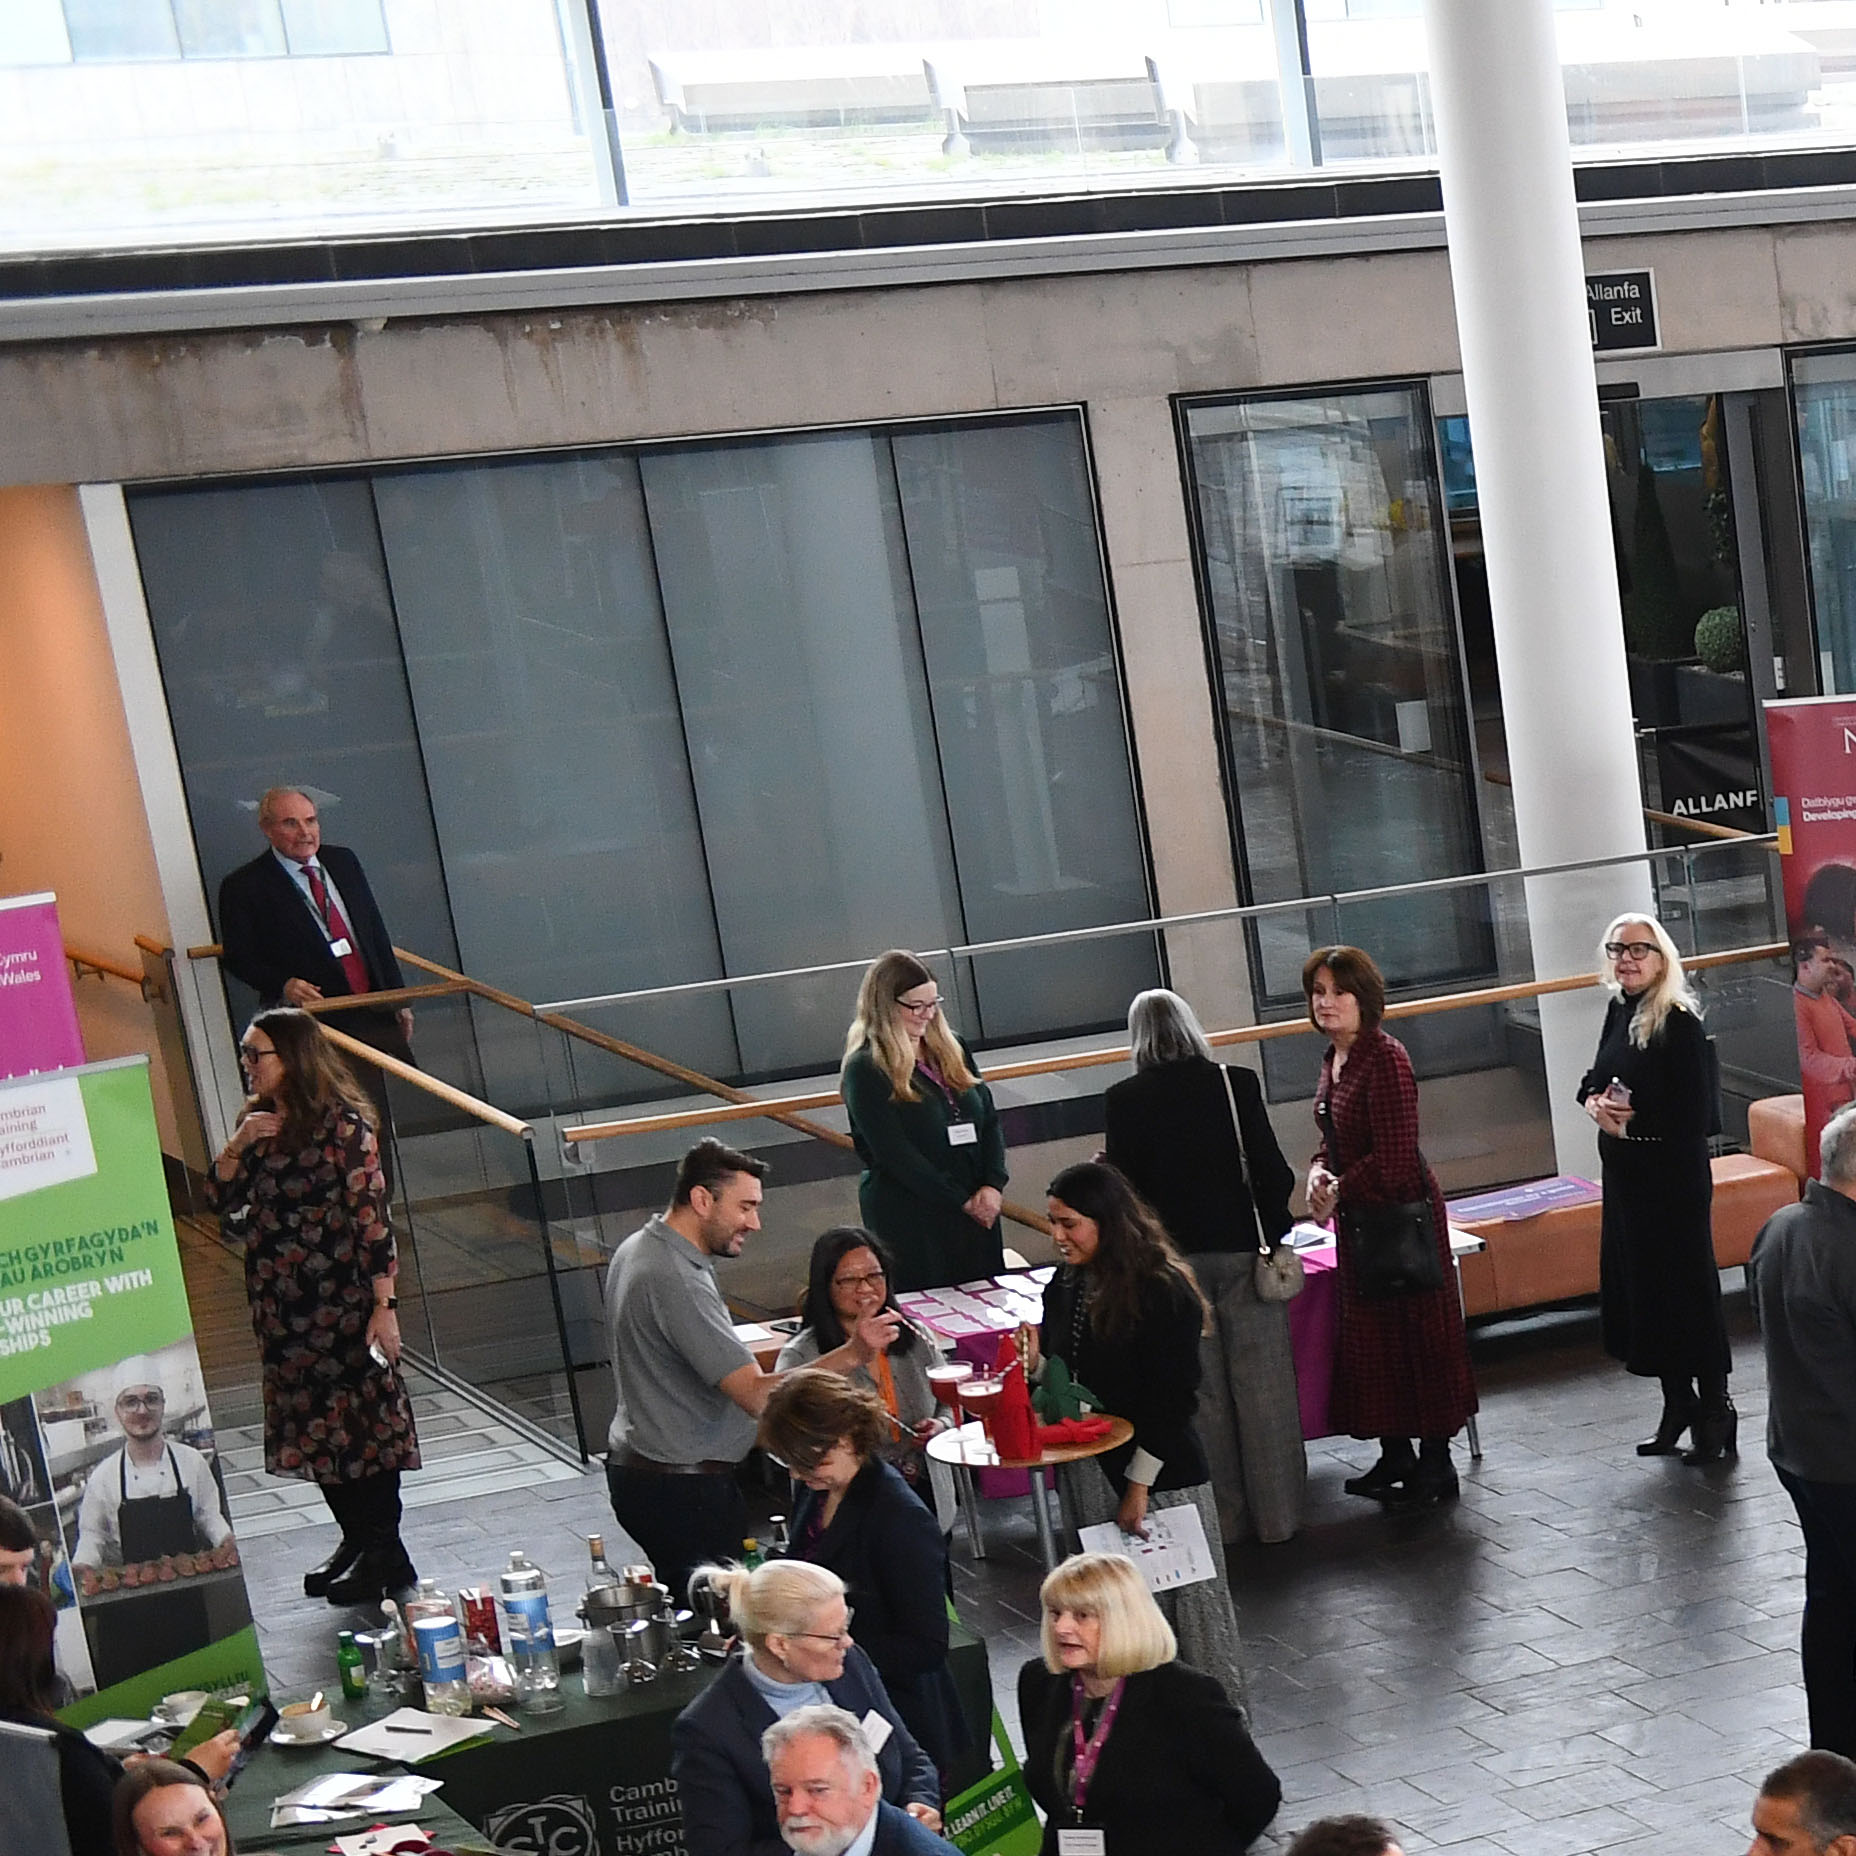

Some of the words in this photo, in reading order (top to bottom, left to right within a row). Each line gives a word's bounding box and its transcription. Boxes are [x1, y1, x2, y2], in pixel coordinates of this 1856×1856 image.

[1587, 281, 1640, 300] Allanfa
[1611, 306, 1643, 325] Exit
[31, 1247, 124, 1281] AROBRYN
[27, 1280, 103, 1310] CAREER
[104, 1268, 153, 1294] WITH
[610, 1777, 679, 1803] Camb
